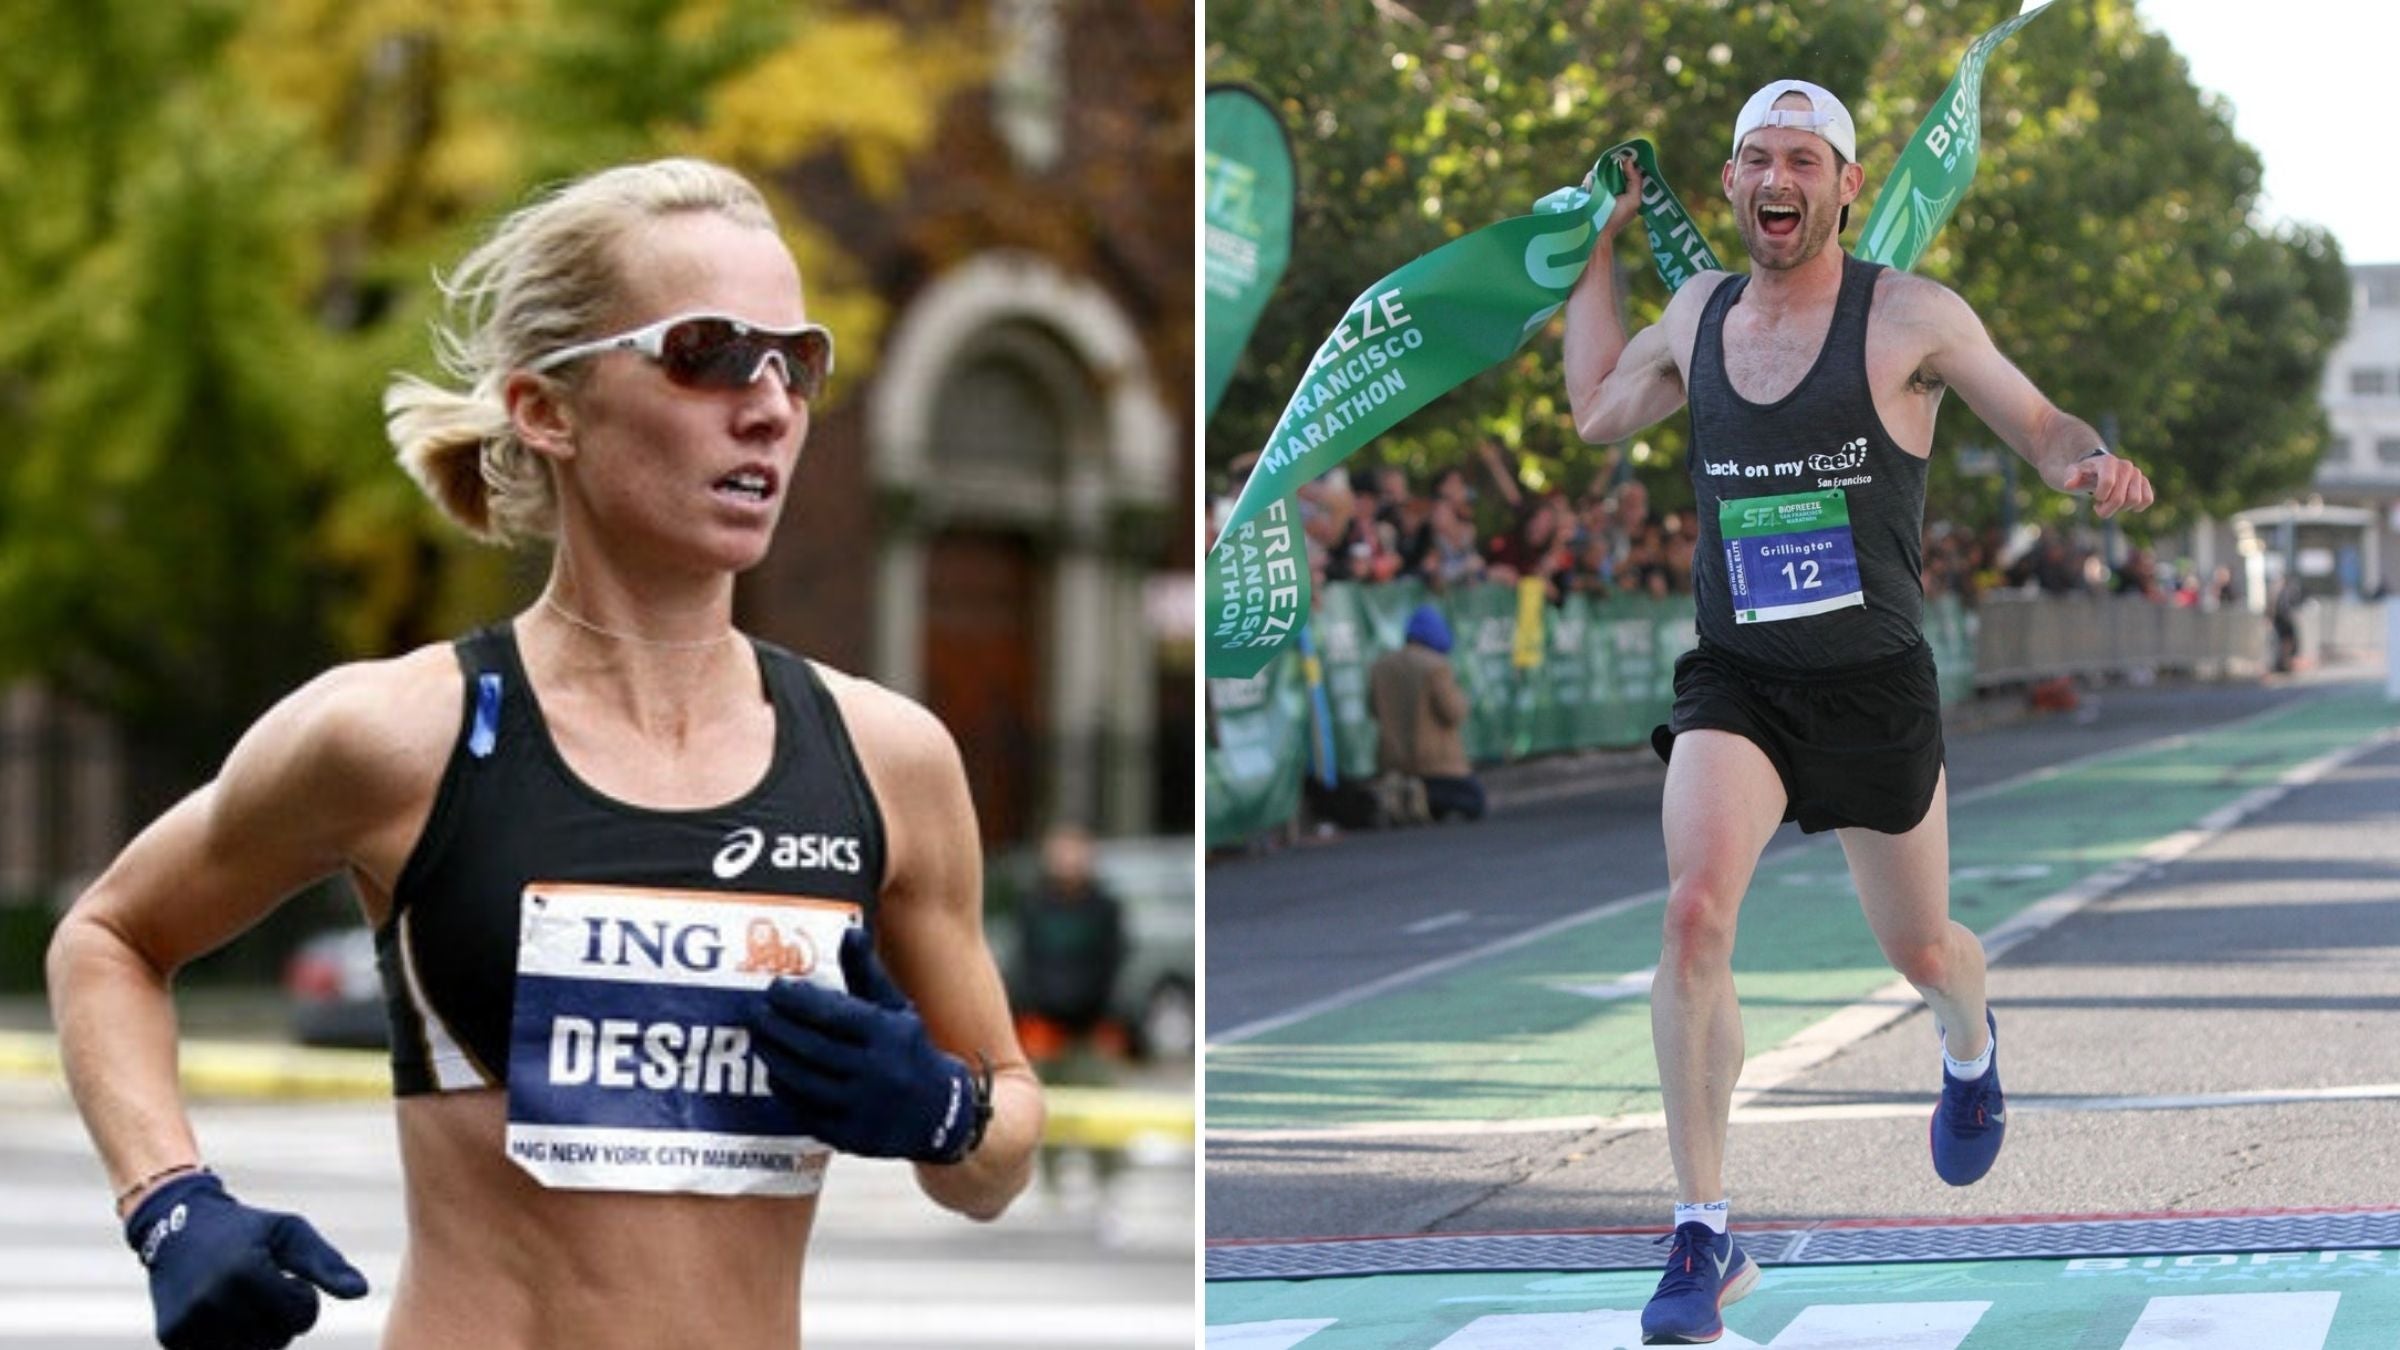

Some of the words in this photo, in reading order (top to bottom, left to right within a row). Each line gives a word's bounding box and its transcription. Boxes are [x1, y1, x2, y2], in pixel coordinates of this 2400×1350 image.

[1263, 368, 1406, 475] MARATHON
[1745, 465, 1769, 477] on
[1775, 460, 1804, 477] my
[1817, 477, 1833, 489] San
[1834, 474, 1872, 487] Francisco
[1731, 541, 1742, 562] ELITE
[1760, 541, 1833, 557] Grillington
[1213, 540, 1240, 636] ATHON
[1248, 499, 1298, 648] FREEZE
[1736, 564, 1747, 596] CORRAL
[1782, 560, 1822, 590] 12
[581, 916, 726, 973] ING
[513, 1141, 547, 1161] ING
[551, 1142, 597, 1163] NEW
[602, 1146, 651, 1166] YORK
[657, 1147, 699, 1168] CITY
[702, 1150, 794, 1172] MARATHON
[2065, 1250, 2386, 1270] BIOFR
